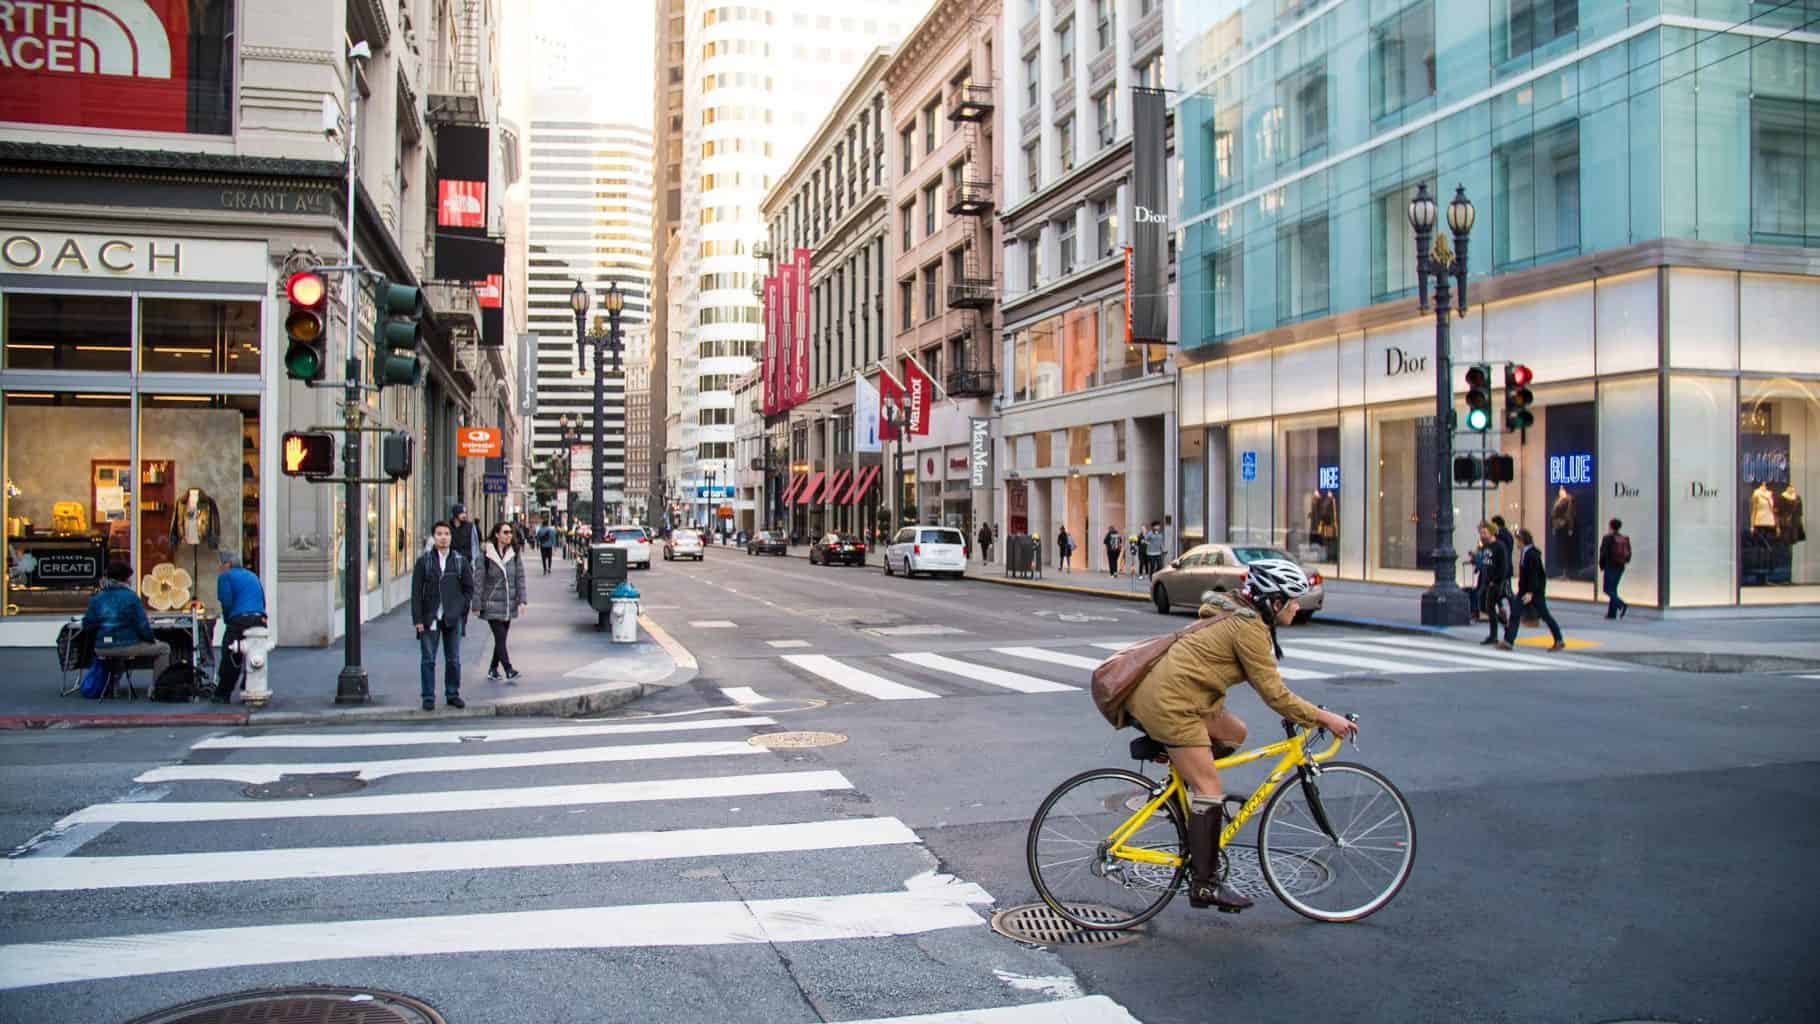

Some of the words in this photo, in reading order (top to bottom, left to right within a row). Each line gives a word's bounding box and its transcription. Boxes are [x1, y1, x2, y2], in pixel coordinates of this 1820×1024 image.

[220, 191, 287, 210] GRANT
[1135, 206, 1168, 223] Dior
[2, 236, 183, 273] OACH
[1384, 347, 1427, 376] Dior
[909, 376, 923, 432] Marmot
[973, 420, 989, 486] MaxMara
[1550, 455, 1591, 483] BLUE
[1613, 481, 1640, 497] Dior
[1691, 480, 1720, 497] Dior
[42, 563, 92, 573] CREATE
